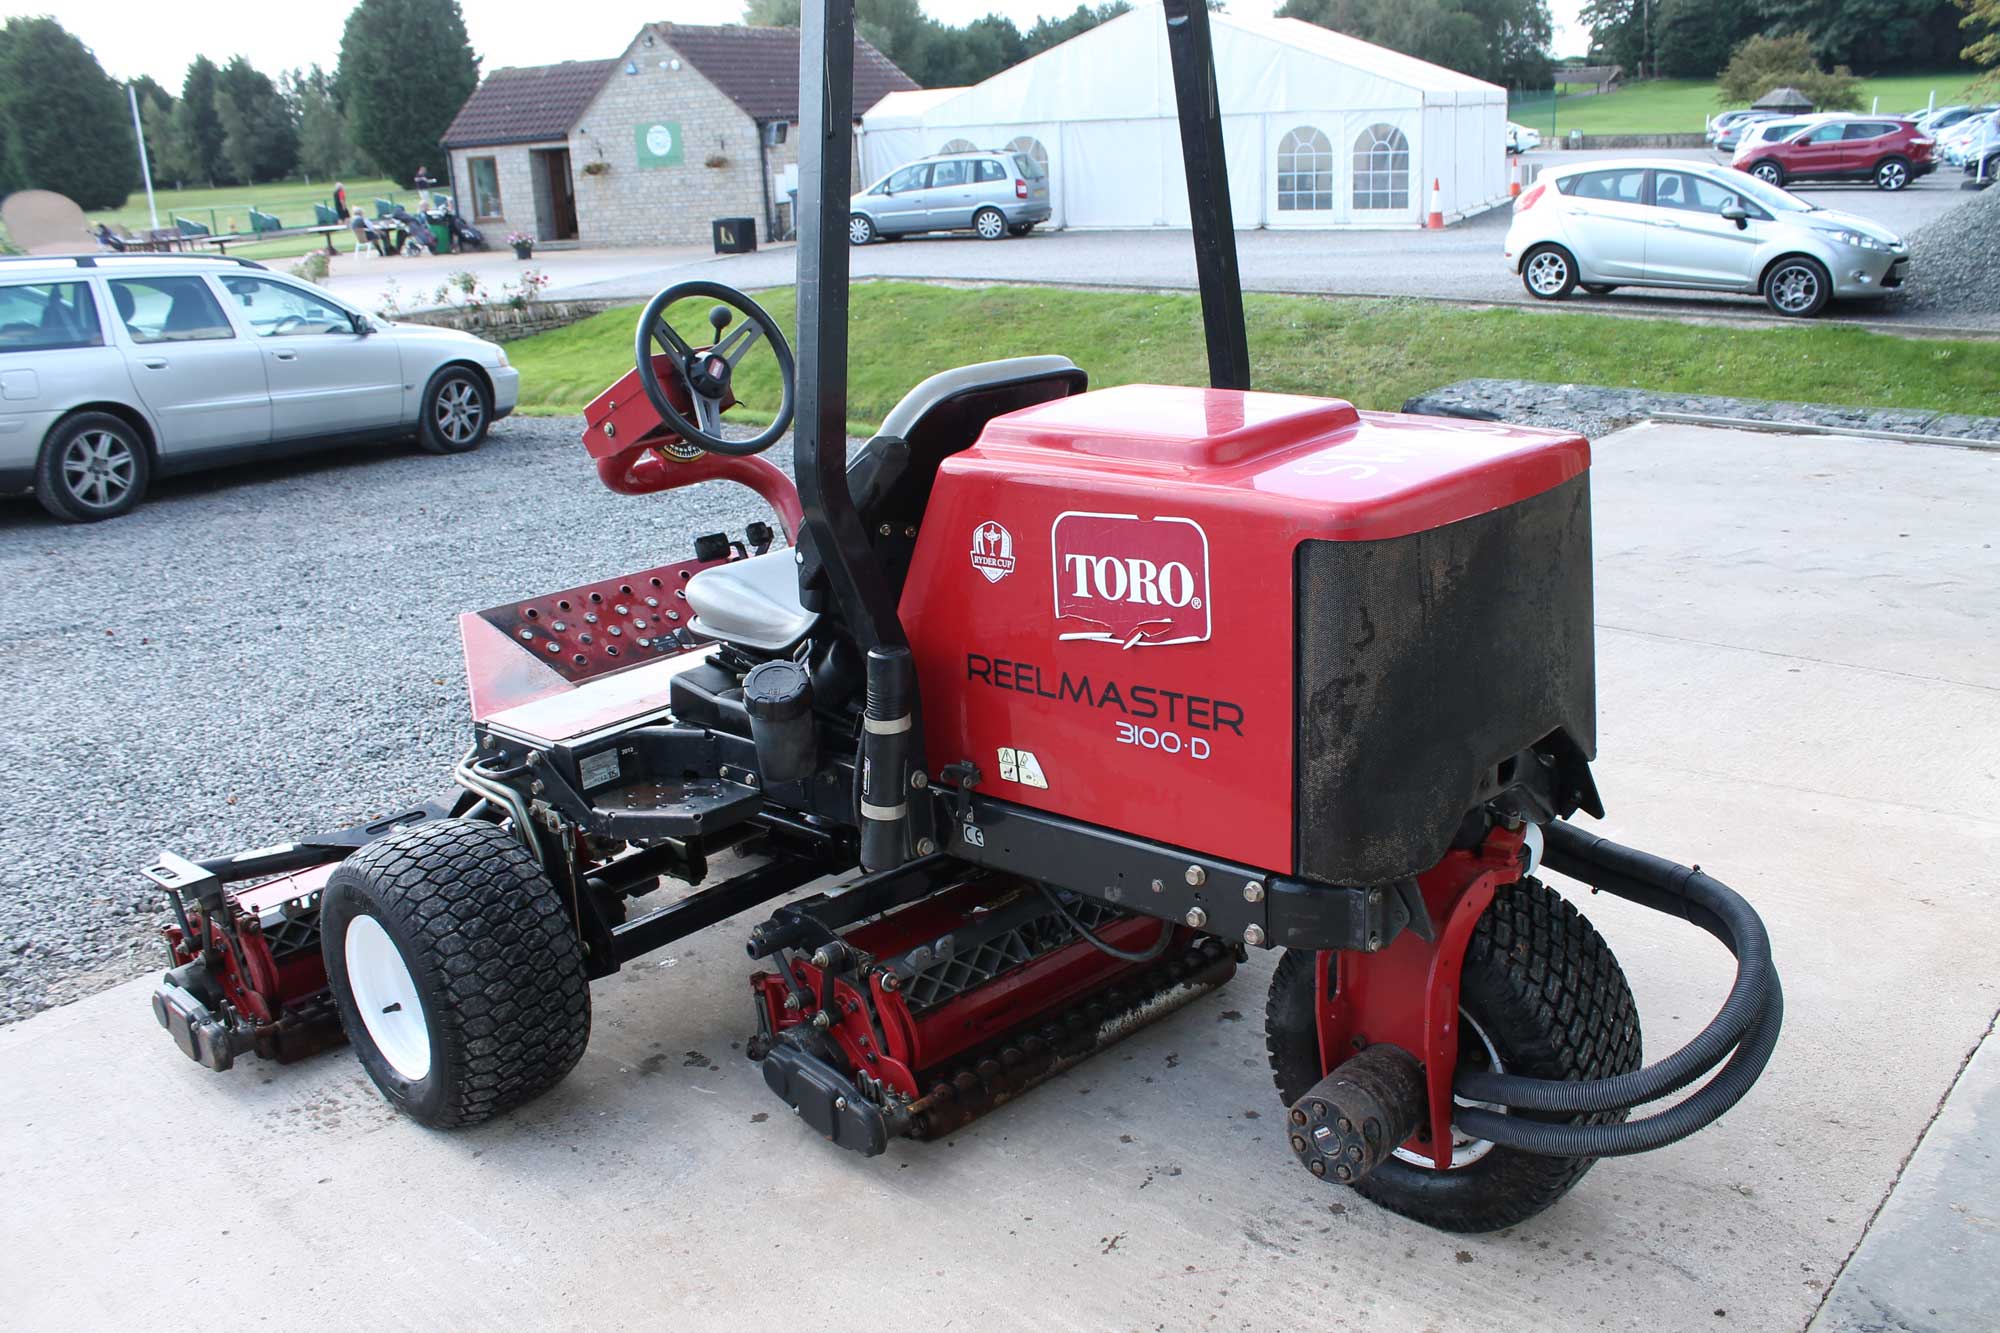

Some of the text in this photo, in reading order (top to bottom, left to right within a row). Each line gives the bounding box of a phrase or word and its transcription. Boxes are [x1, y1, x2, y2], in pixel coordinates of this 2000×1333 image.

[974, 555, 1012, 568] RYDER CUP
[1065, 554, 1195, 608] TORO
[967, 653, 1244, 736] REELMASTER
[965, 826, 983, 846] CE
